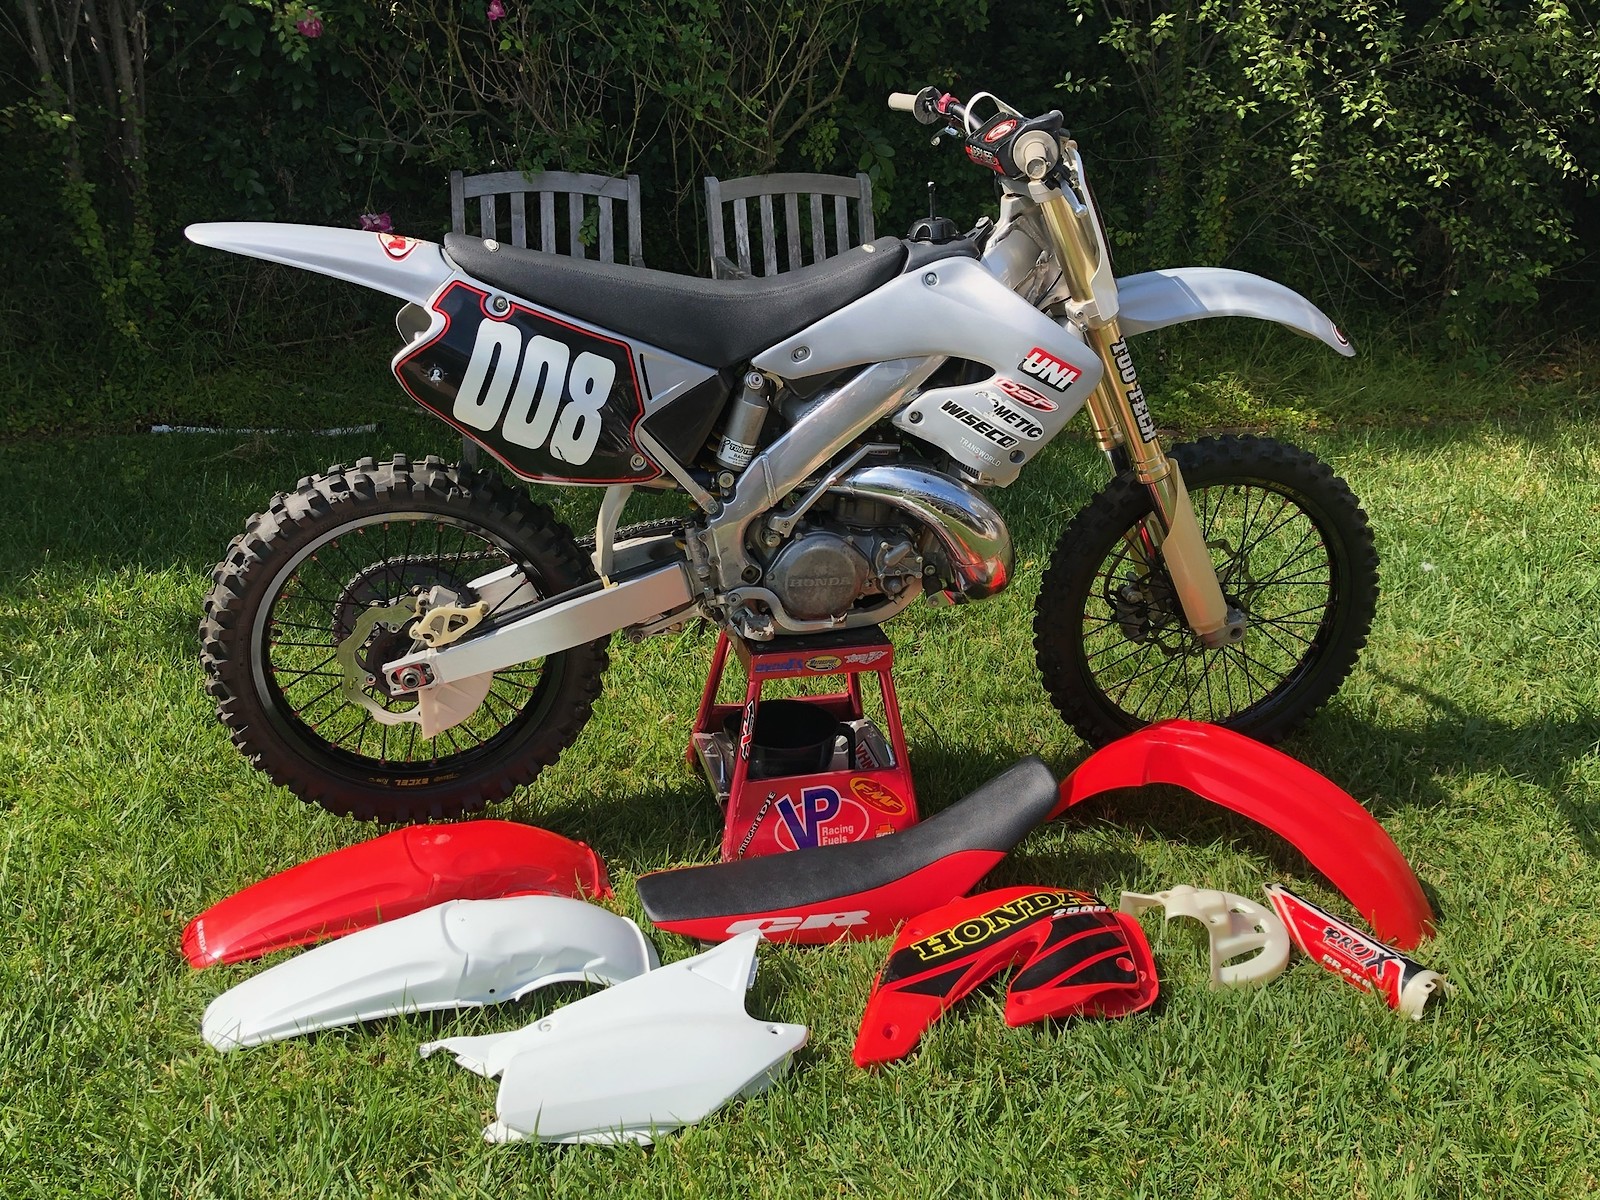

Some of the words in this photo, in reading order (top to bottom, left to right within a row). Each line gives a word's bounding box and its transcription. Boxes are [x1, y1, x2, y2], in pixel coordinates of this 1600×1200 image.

[1022, 352, 1079, 390] UNI
[453, 318, 616, 466] 008
[1110, 335, 1137, 385] TOO
[1127, 382, 1156, 444] TECH
[940, 400, 1018, 449] WISECO
[959, 436, 1002, 467] TRANSWORLD
[789, 576, 852, 588] HONDA
[853, 782, 904, 810] FMF
[774, 785, 842, 850] VP
[821, 824, 855, 836] Racing
[822, 834, 848, 846] Fuels
[725, 909, 871, 934] CR
[910, 889, 1100, 961] HONDA
[1322, 953, 1373, 989] BRAKI
